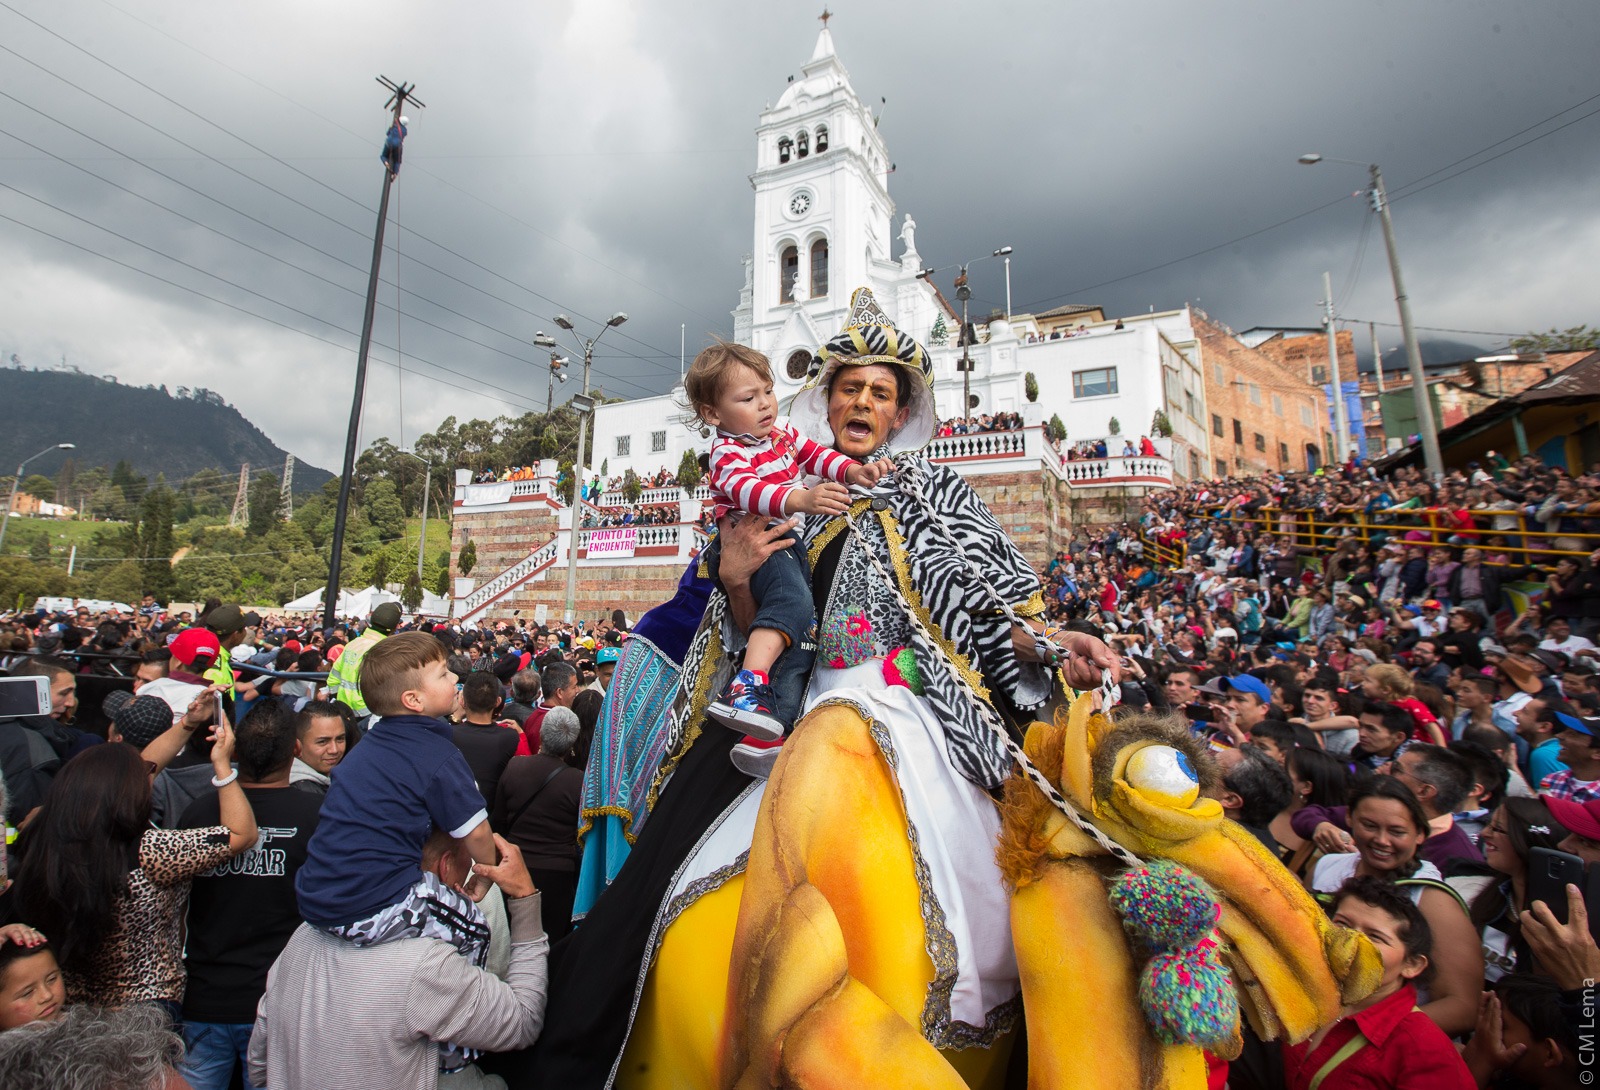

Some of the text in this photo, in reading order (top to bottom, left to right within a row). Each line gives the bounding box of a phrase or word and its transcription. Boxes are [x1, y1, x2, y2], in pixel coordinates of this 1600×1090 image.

[591, 528, 637, 541] PUNTO DE
[589, 540, 636, 552] ENCUENTRO
